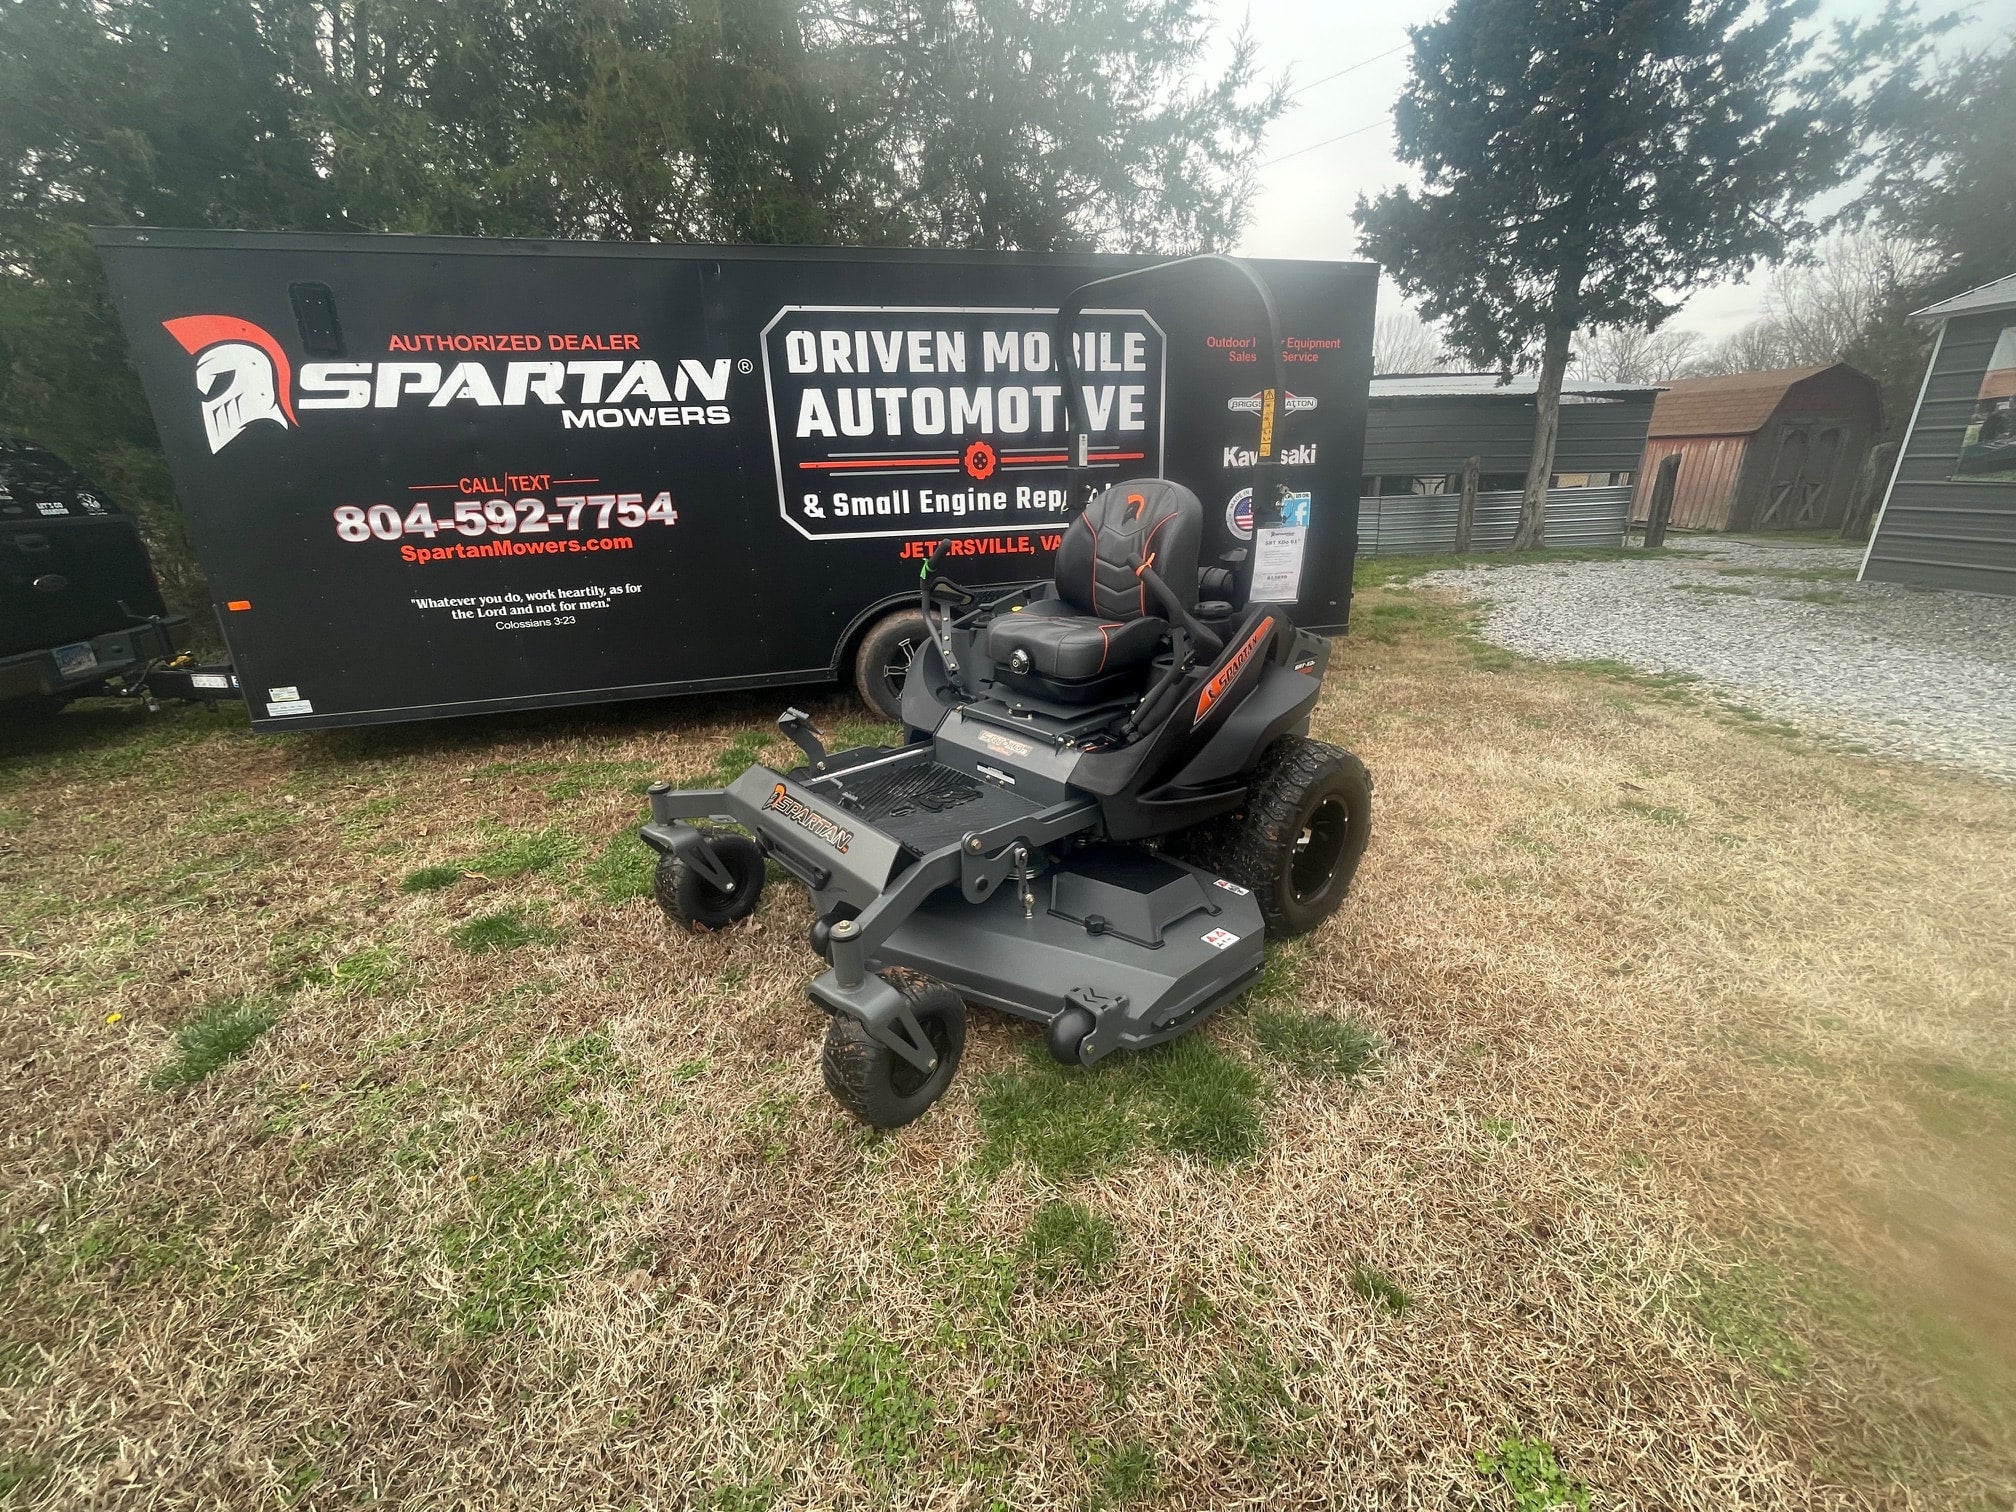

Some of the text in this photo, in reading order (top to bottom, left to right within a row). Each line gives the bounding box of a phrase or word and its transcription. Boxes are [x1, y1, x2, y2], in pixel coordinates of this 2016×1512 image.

[389, 334, 641, 352] AUTHORIZED DEALER
[785, 331, 966, 374] DRIVEN
[1206, 336, 1250, 348] Outdoor
[1286, 337, 1341, 350] Equipment
[1228, 350, 1257, 362] Sales
[1282, 350, 1319, 362] Service
[298, 359, 732, 409] SPARTAN
[561, 405, 732, 429] MOWERS
[796, 385, 1146, 438] AUTOMOTVE
[1223, 443, 1317, 467] Kasaki
[803, 493, 826, 518] &
[834, 489, 909, 517] Small
[920, 485, 1007, 516] Engine
[333, 491, 679, 542] 804-592-7754
[401, 535, 633, 564] SpartanMowers.com
[900, 534, 1063, 559] JETRSVILLE, VA
[410, 583, 642, 609] "Whatever you do, work heartily, as for
[451, 597, 611, 620] the Lord and not for men."
[495, 615, 576, 631] Colossians 3:23
[1218, 636, 1257, 689] SPARTAN
[774, 795, 853, 851] SPARTAN
